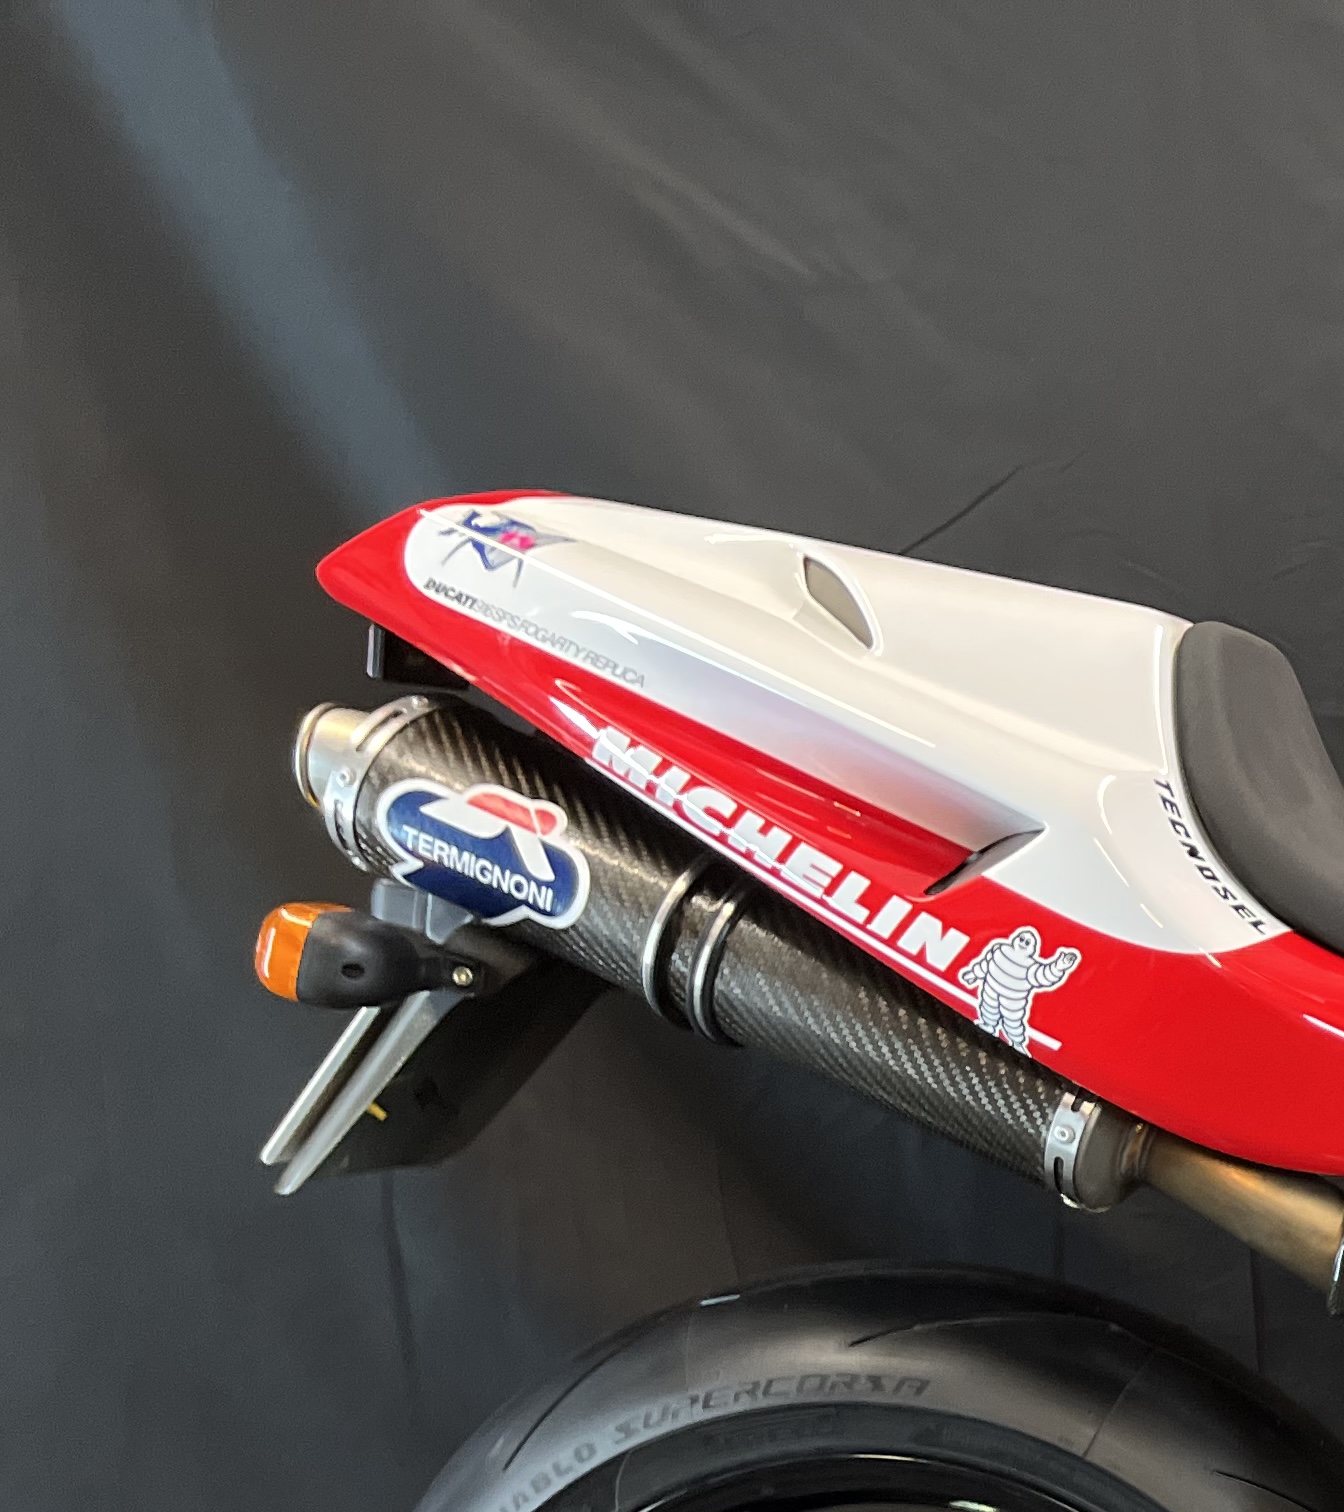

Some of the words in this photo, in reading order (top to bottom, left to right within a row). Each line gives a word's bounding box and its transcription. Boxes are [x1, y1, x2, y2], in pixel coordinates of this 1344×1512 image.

[403, 829, 554, 912] TERMIGNONI
[594, 728, 970, 973] MICHELIN
[1153, 778, 1266, 936] TECNOSEL
